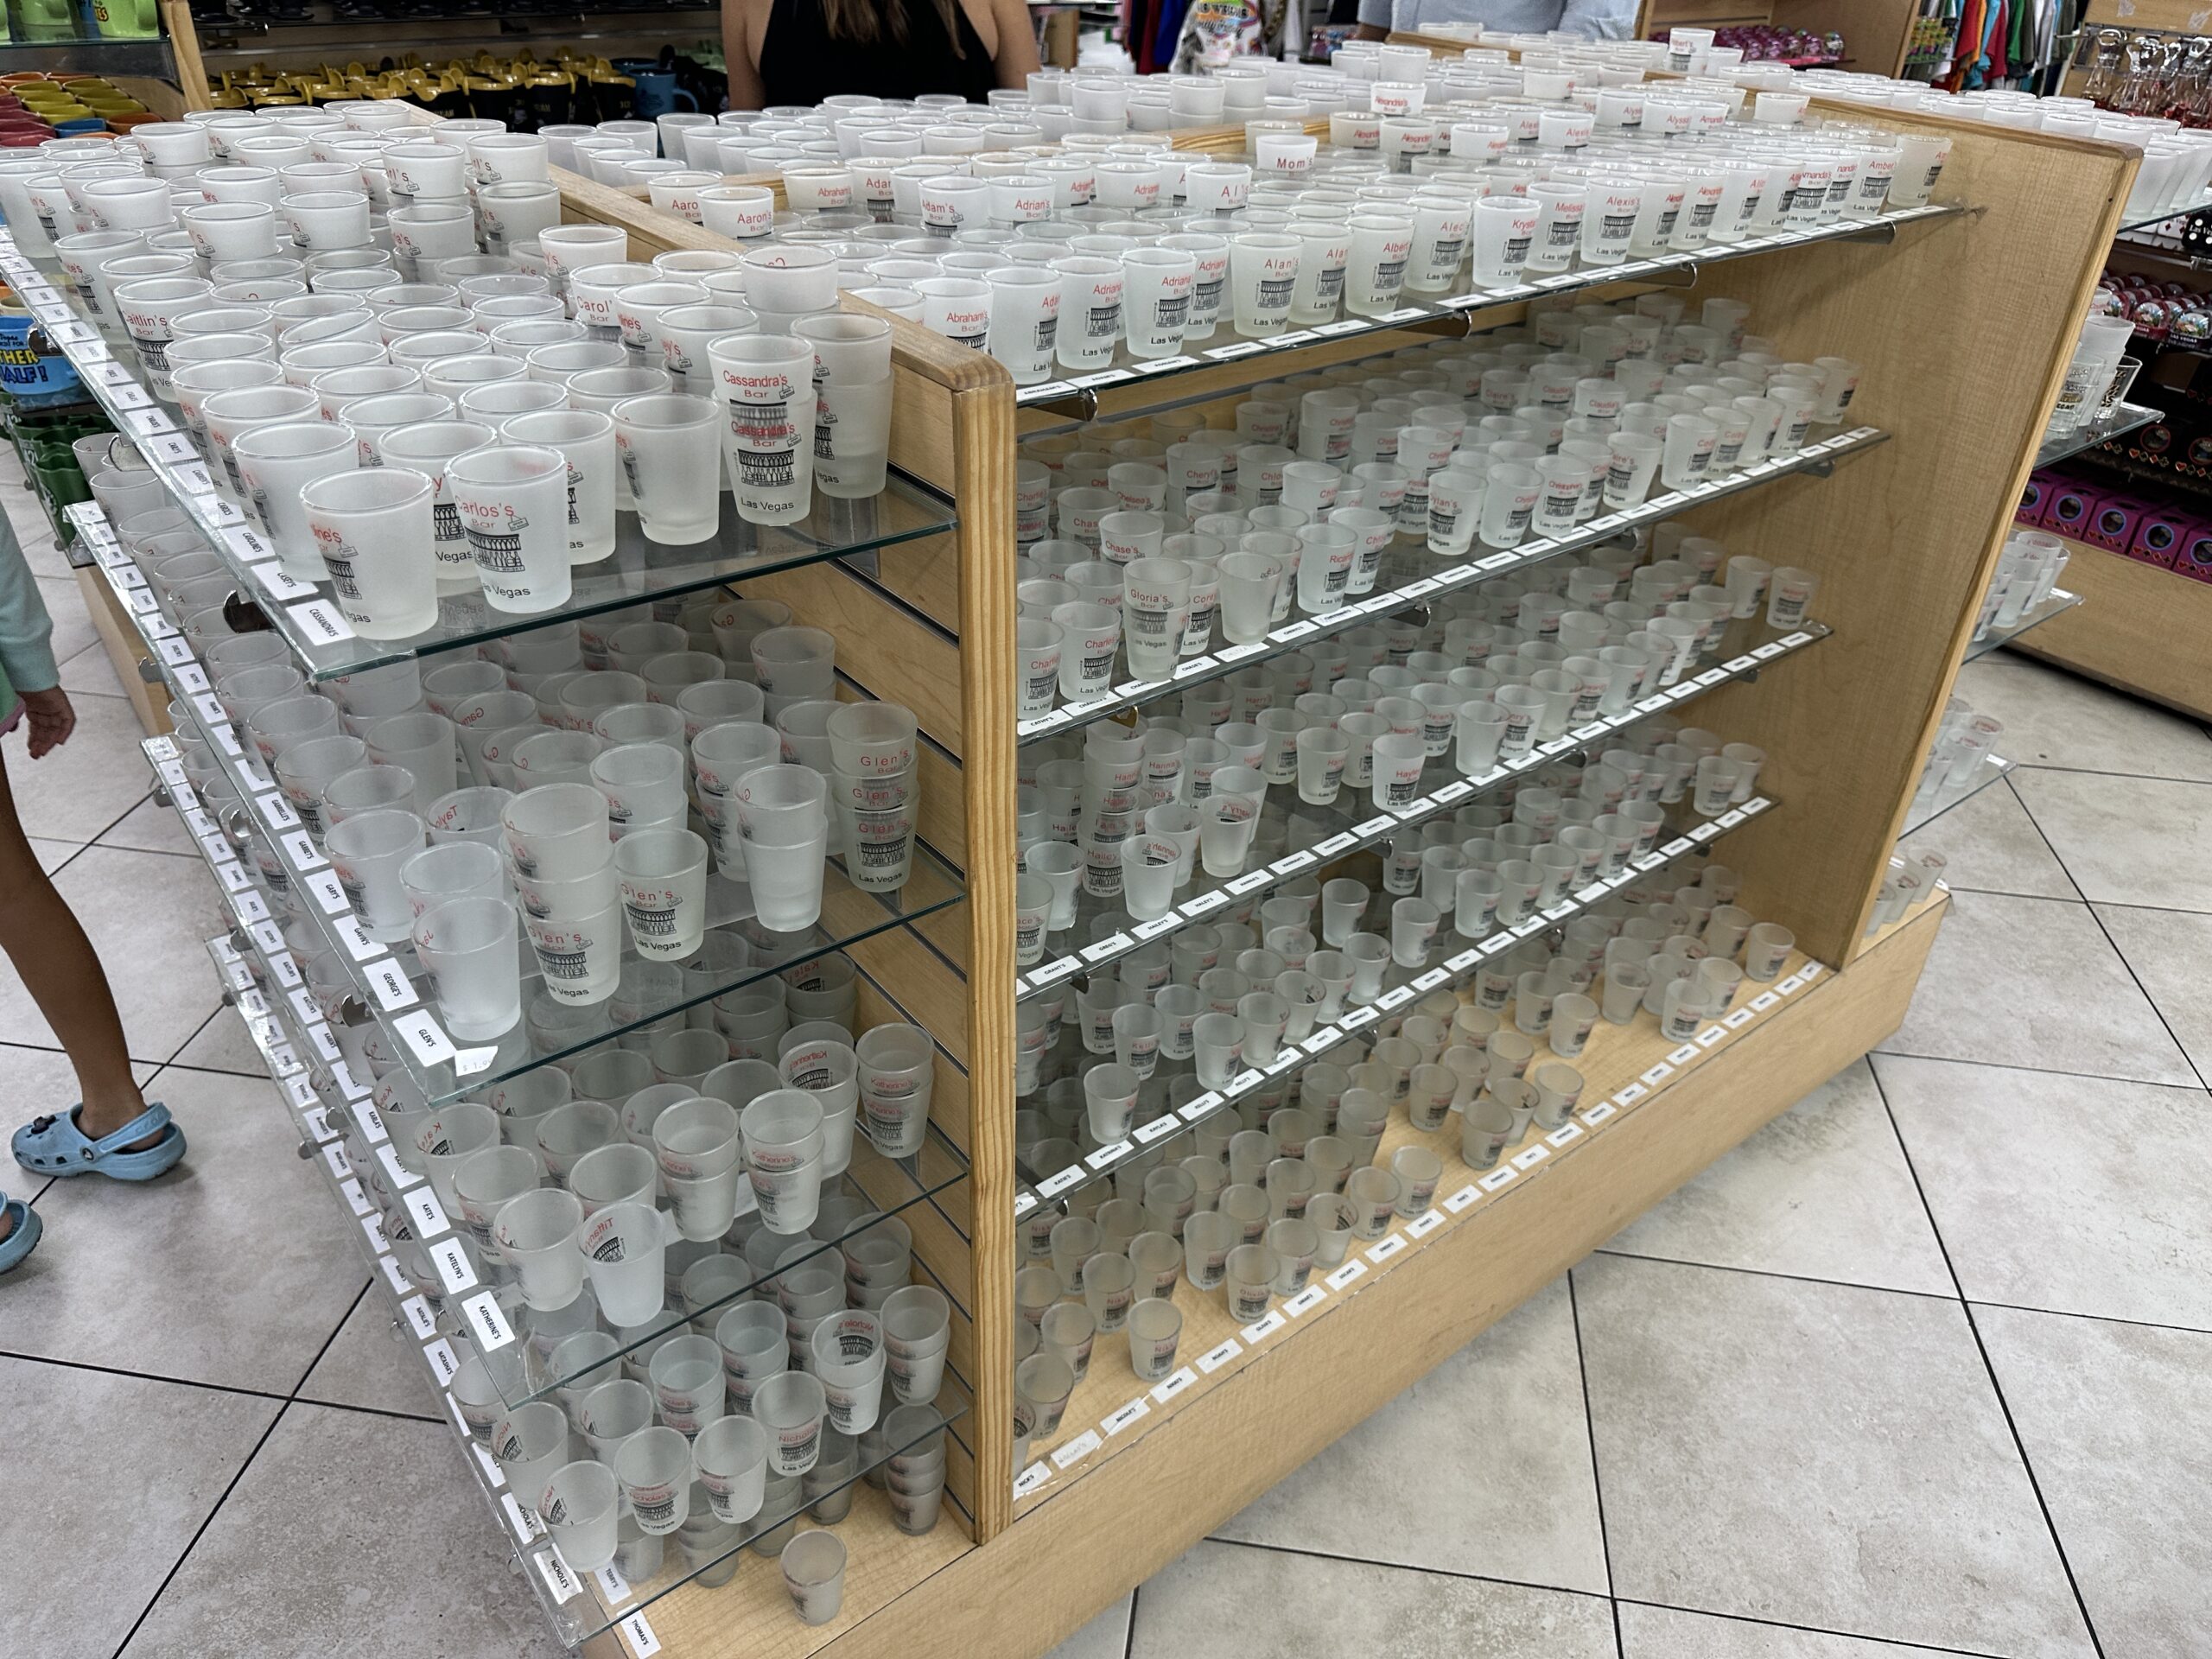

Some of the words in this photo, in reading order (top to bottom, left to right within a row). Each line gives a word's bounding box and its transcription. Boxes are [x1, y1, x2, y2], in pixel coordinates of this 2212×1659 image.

[1276, 157, 1313, 169] Mom's
[1868, 160, 1896, 170] Amber
[921, 200, 956, 213] Adam's
[1014, 199, 1051, 211] Adrian's
[737, 211, 772, 224] Aaron's
[1440, 221, 1465, 232] Alec
[1264, 257, 1300, 270] Alan's
[576, 296, 613, 312] Carol'
[946, 309, 988, 323] Abraham's
[1254, 317, 1269, 326] Las
[961, 324, 981, 333] Bar
[1150, 335, 1166, 345] Las
[0, 350, 40, 365] THER
[1082, 347, 1098, 357] Las
[0, 365, 49, 383] ALF!
[723, 371, 788, 387] Cassandra's
[744, 390, 768, 398] Bar
[731, 422, 795, 438] Cassandra's
[753, 439, 777, 448] Bar
[217, 501, 234, 516] CAROL'S
[455, 495, 514, 517] Carlos's
[741, 497, 758, 509] Las
[760, 501, 794, 512] Vegas
[471, 519, 497, 529] Bar
[242, 531, 265, 554] CAROLINE'S
[1105, 540, 1139, 554] Chase's
[435, 550, 474, 562] Vegas
[493, 587, 531, 597] Vegas
[1130, 588, 1168, 603] Gloria's
[308, 608, 339, 637] CASSANDRA'S
[1181, 662, 1203, 671] CHASE'S
[1030, 716, 1055, 727] CATHY'S
[860, 750, 909, 767] Glen's
[852, 786, 904, 800] Glen's
[271, 799, 290, 822] GABRIELLE'S
[858, 817, 909, 835] Glen's
[298, 840, 314, 860] GARRET'S
[858, 873, 874, 883] Las
[877, 872, 902, 884] Vegas
[325, 883, 340, 899] GARY'S
[620, 883, 673, 901] Glen's
[353, 926, 371, 946] GAVIN'S
[528, 925, 582, 944] Glen's
[651, 939, 682, 952] Vegas
[1098, 940, 1116, 951] GREG'S
[1044, 963, 1067, 976] GRANT'S
[383, 972, 403, 997] GEORGE'S
[558, 988, 589, 997] Vegas
[323, 1033, 338, 1048] KAREN'S
[418, 1028, 436, 1048] GLEN'S
[368, 1111, 383, 1128] KARLA'S
[1053, 1173, 1071, 1186] KATIE'S
[422, 1203, 435, 1220] KATE'S
[446, 1251, 465, 1279] KATELYN'S
[416, 1305, 431, 1328] NATALIE'S
[478, 1305, 502, 1340] KATHERINE'S
[437, 1350, 454, 1376] NATASHA'S
[1018, 1473, 1035, 1487] NICK'S
[551, 1559, 570, 1589] NICHOLE'S
[604, 1567, 620, 1588] TERRY'S
[632, 1619, 650, 1646] THOMAS'S
